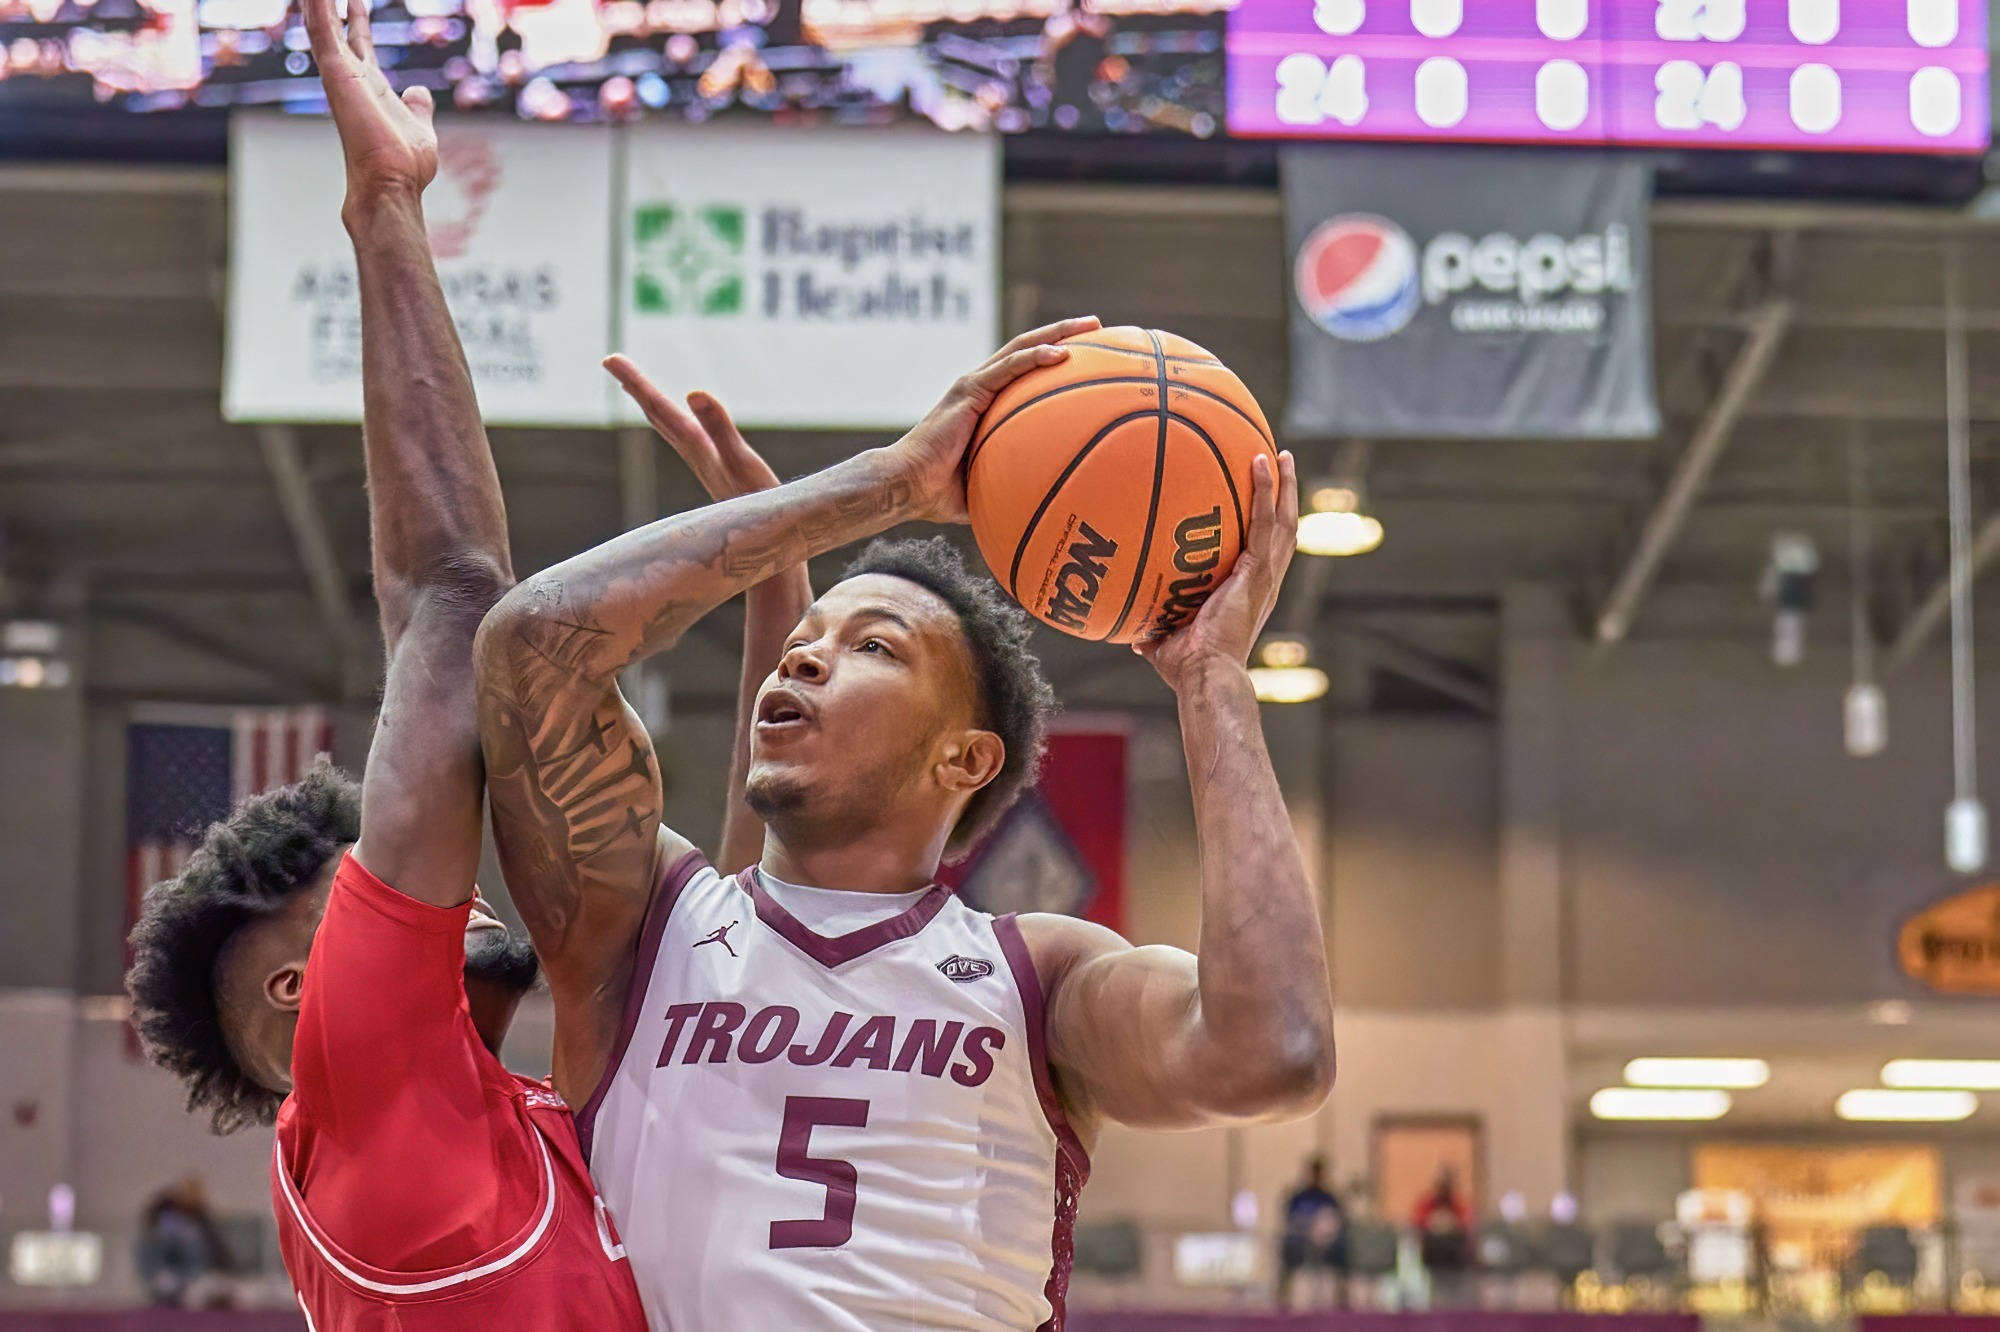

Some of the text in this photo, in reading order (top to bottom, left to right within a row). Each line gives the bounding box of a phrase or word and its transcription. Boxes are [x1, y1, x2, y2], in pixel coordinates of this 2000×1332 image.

[1275, 53, 1961, 137] 24 0 0 24 0 0
[761, 205, 973, 272] Baptist
[1421, 222, 1631, 306] pepsi
[761, 270, 971, 321] Health
[1044, 520, 1119, 632] NCAA
[655, 1001, 1006, 1088] TROJANS
[769, 1095, 870, 1249] 5
